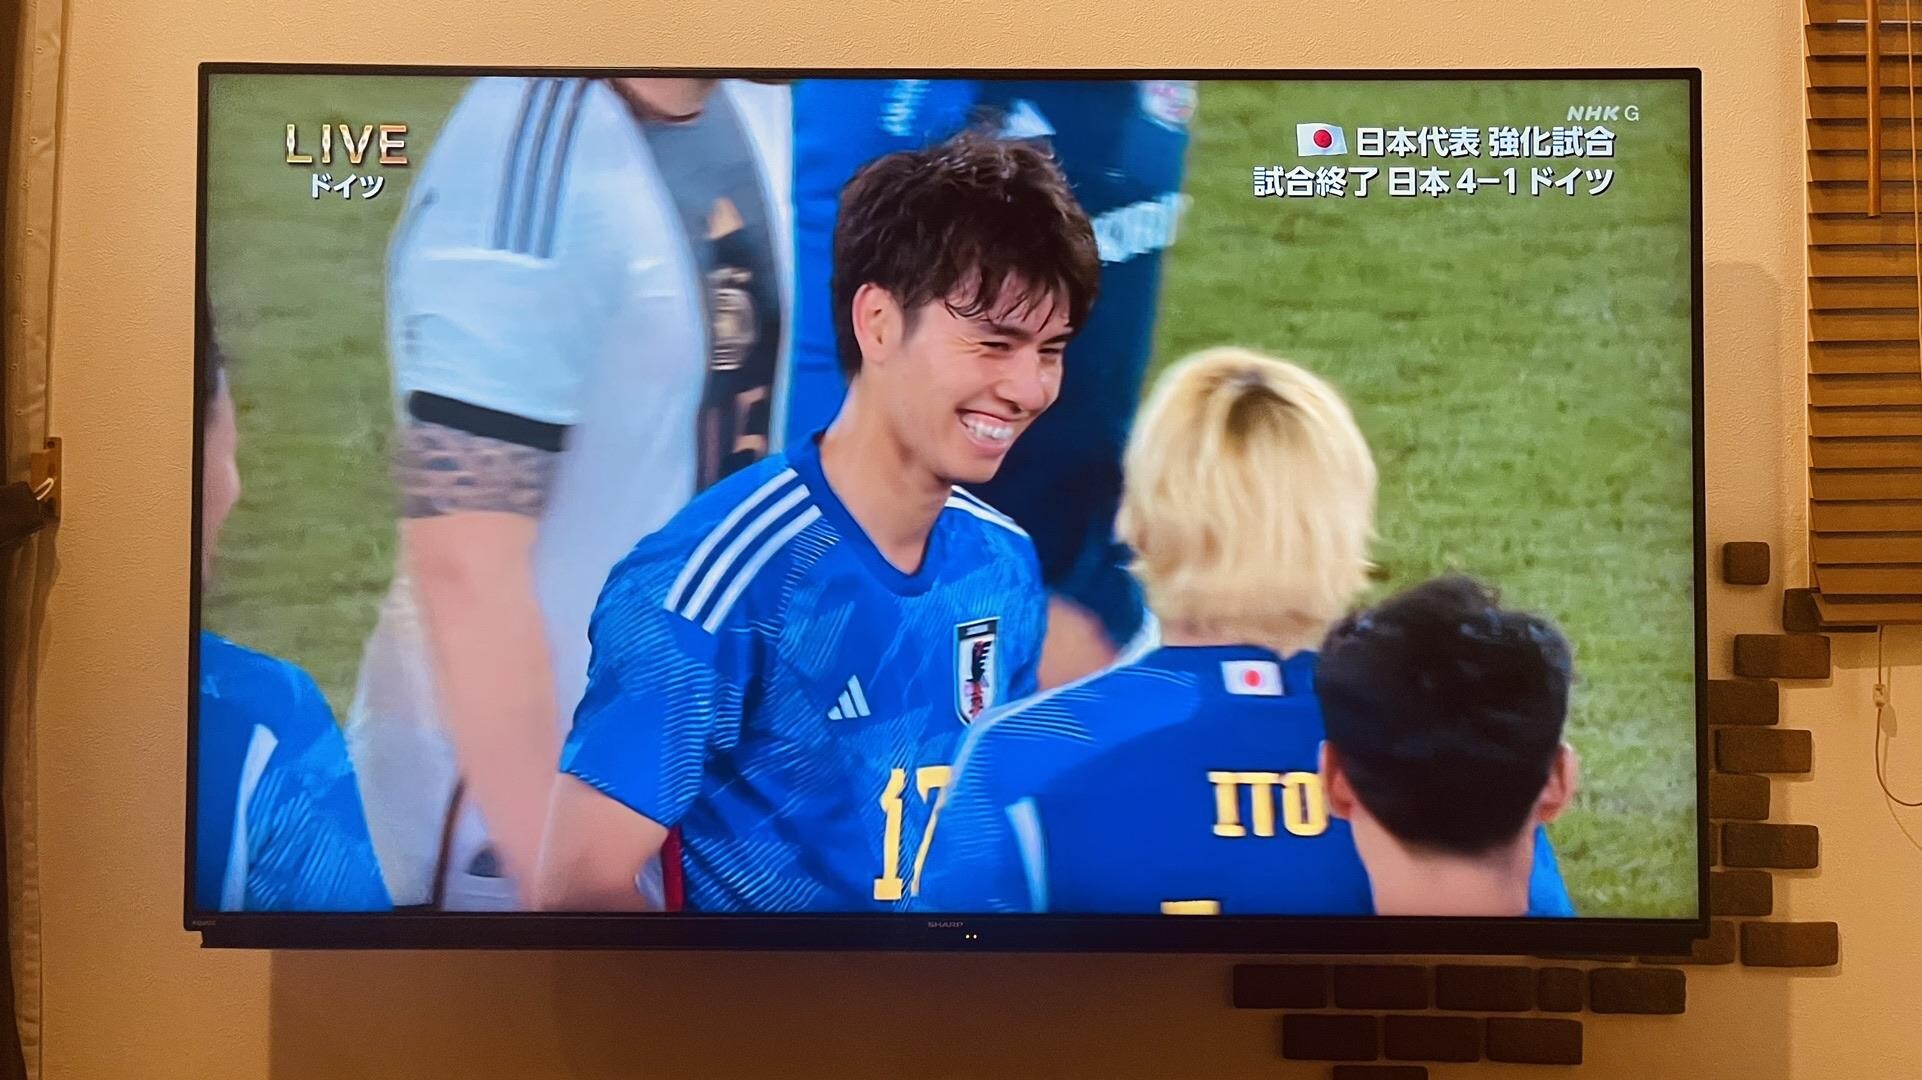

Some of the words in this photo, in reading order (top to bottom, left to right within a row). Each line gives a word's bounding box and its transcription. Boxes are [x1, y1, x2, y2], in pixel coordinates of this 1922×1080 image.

[1567, 105, 1620, 122] NHK
[1624, 105, 1640, 122] G
[286, 123, 408, 164] LIVE
[1356, 125, 1481, 158] 日本代表
[1488, 125, 1616, 158] 強化試合
[311, 172, 385, 199] ドイツ
[1253, 165, 1379, 197] 試合終了
[1389, 165, 1451, 197] 日本
[1531, 166, 1614, 196] ドイツ
[1207, 771, 1328, 837] ITO
[873, 765, 956, 901] 17
